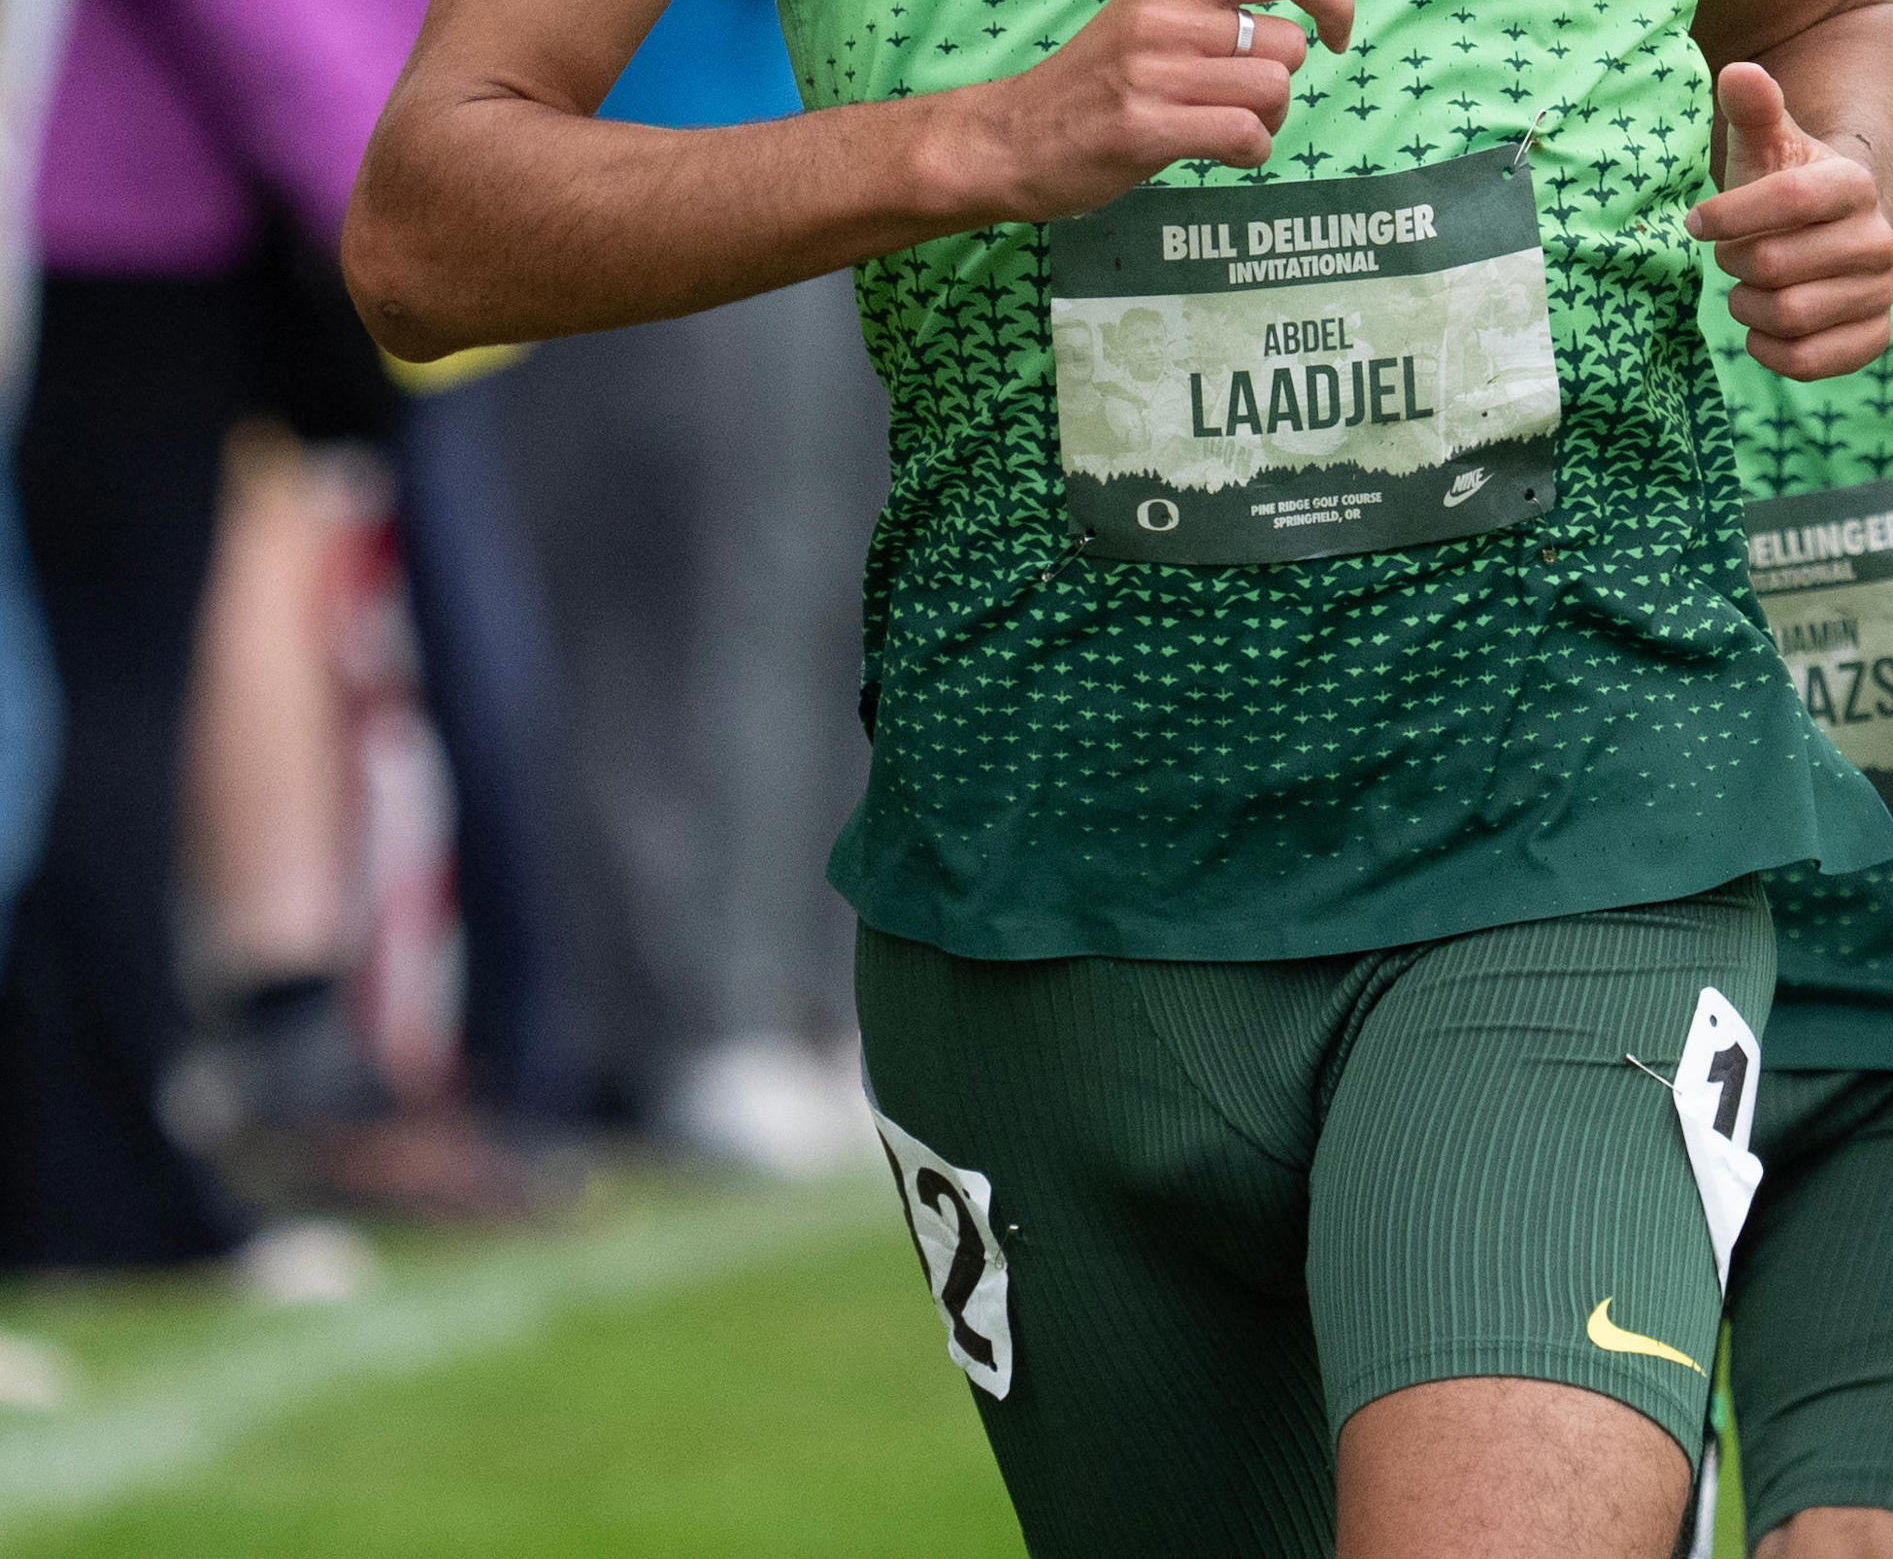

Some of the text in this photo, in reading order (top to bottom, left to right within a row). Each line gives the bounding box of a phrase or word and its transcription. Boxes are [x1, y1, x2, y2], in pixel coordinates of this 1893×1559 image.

[1162, 204, 1437, 261] BILL DELLINGER
[1229, 250, 1379, 284] INVITATIONAL
[1264, 317, 1354, 357] ABDEL
[1190, 356, 1434, 438] LAADJEL
[1251, 492, 1382, 516] PINE RIDGE GOLF COURSE
[1273, 509, 1361, 529] SPRINGFIELD, OR
